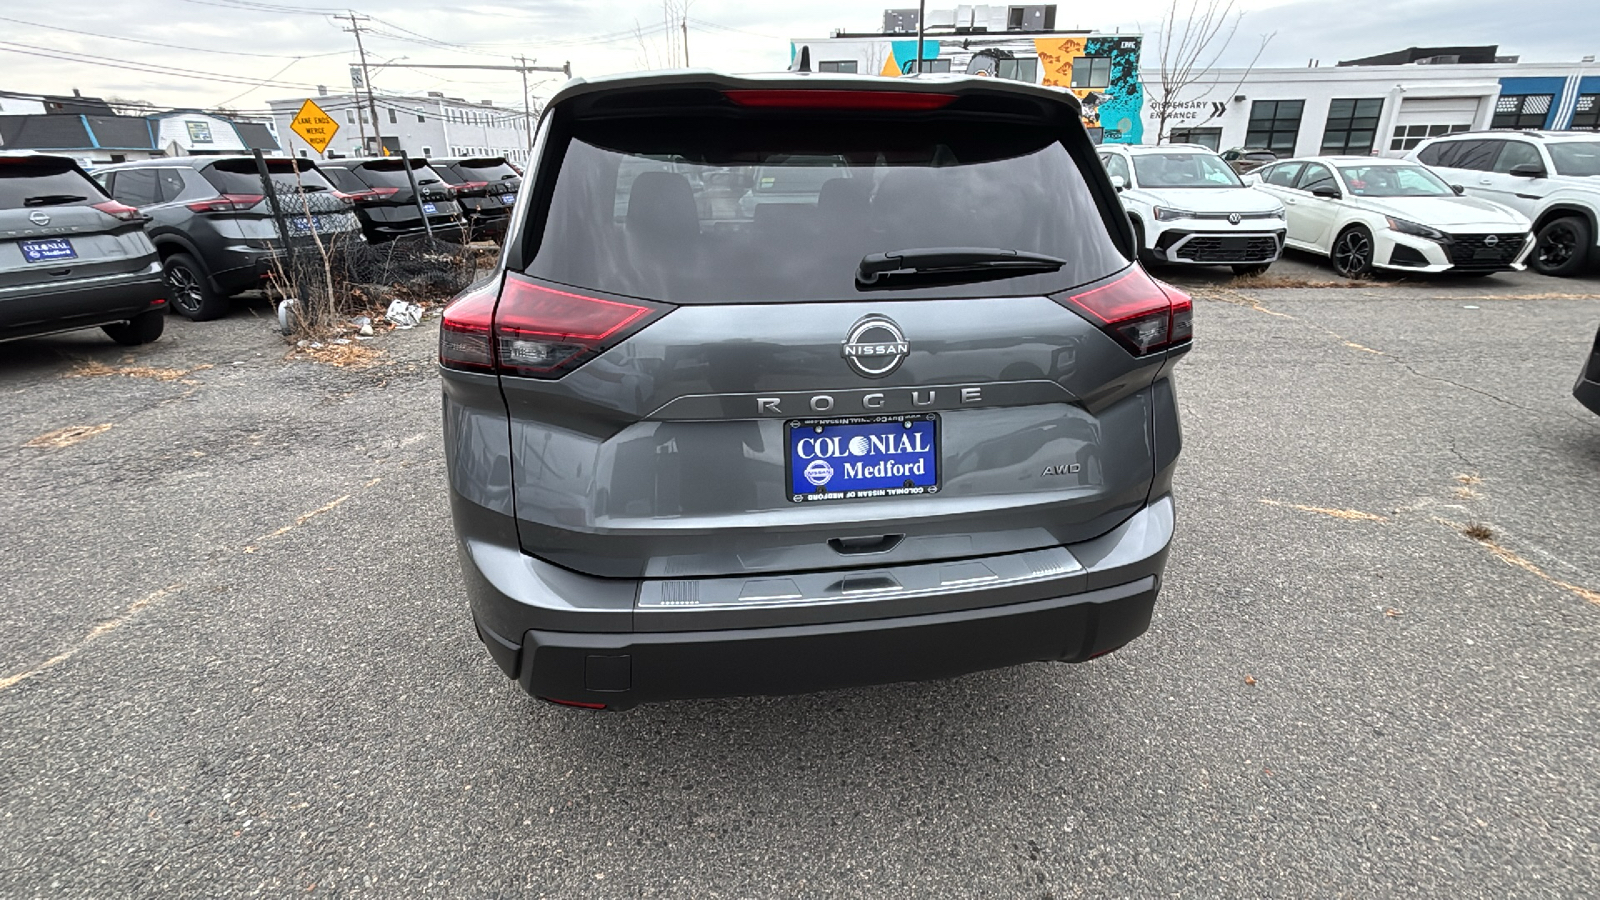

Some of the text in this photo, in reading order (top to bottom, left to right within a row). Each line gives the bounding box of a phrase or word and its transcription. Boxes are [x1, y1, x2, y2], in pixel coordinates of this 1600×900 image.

[297, 117, 313, 125] LANE
[1149, 111, 1198, 120] ENRANCE
[305, 127, 326, 135] MERGE
[845, 344, 908, 356] NISSAN
[756, 387, 983, 414] ROGUE
[797, 432, 930, 459] COLONIAL
[843, 458, 925, 480] Medford
[1040, 463, 1081, 477] AWD
[807, 487, 924, 501] COLONIAL NISSAN OF MEDFORD
